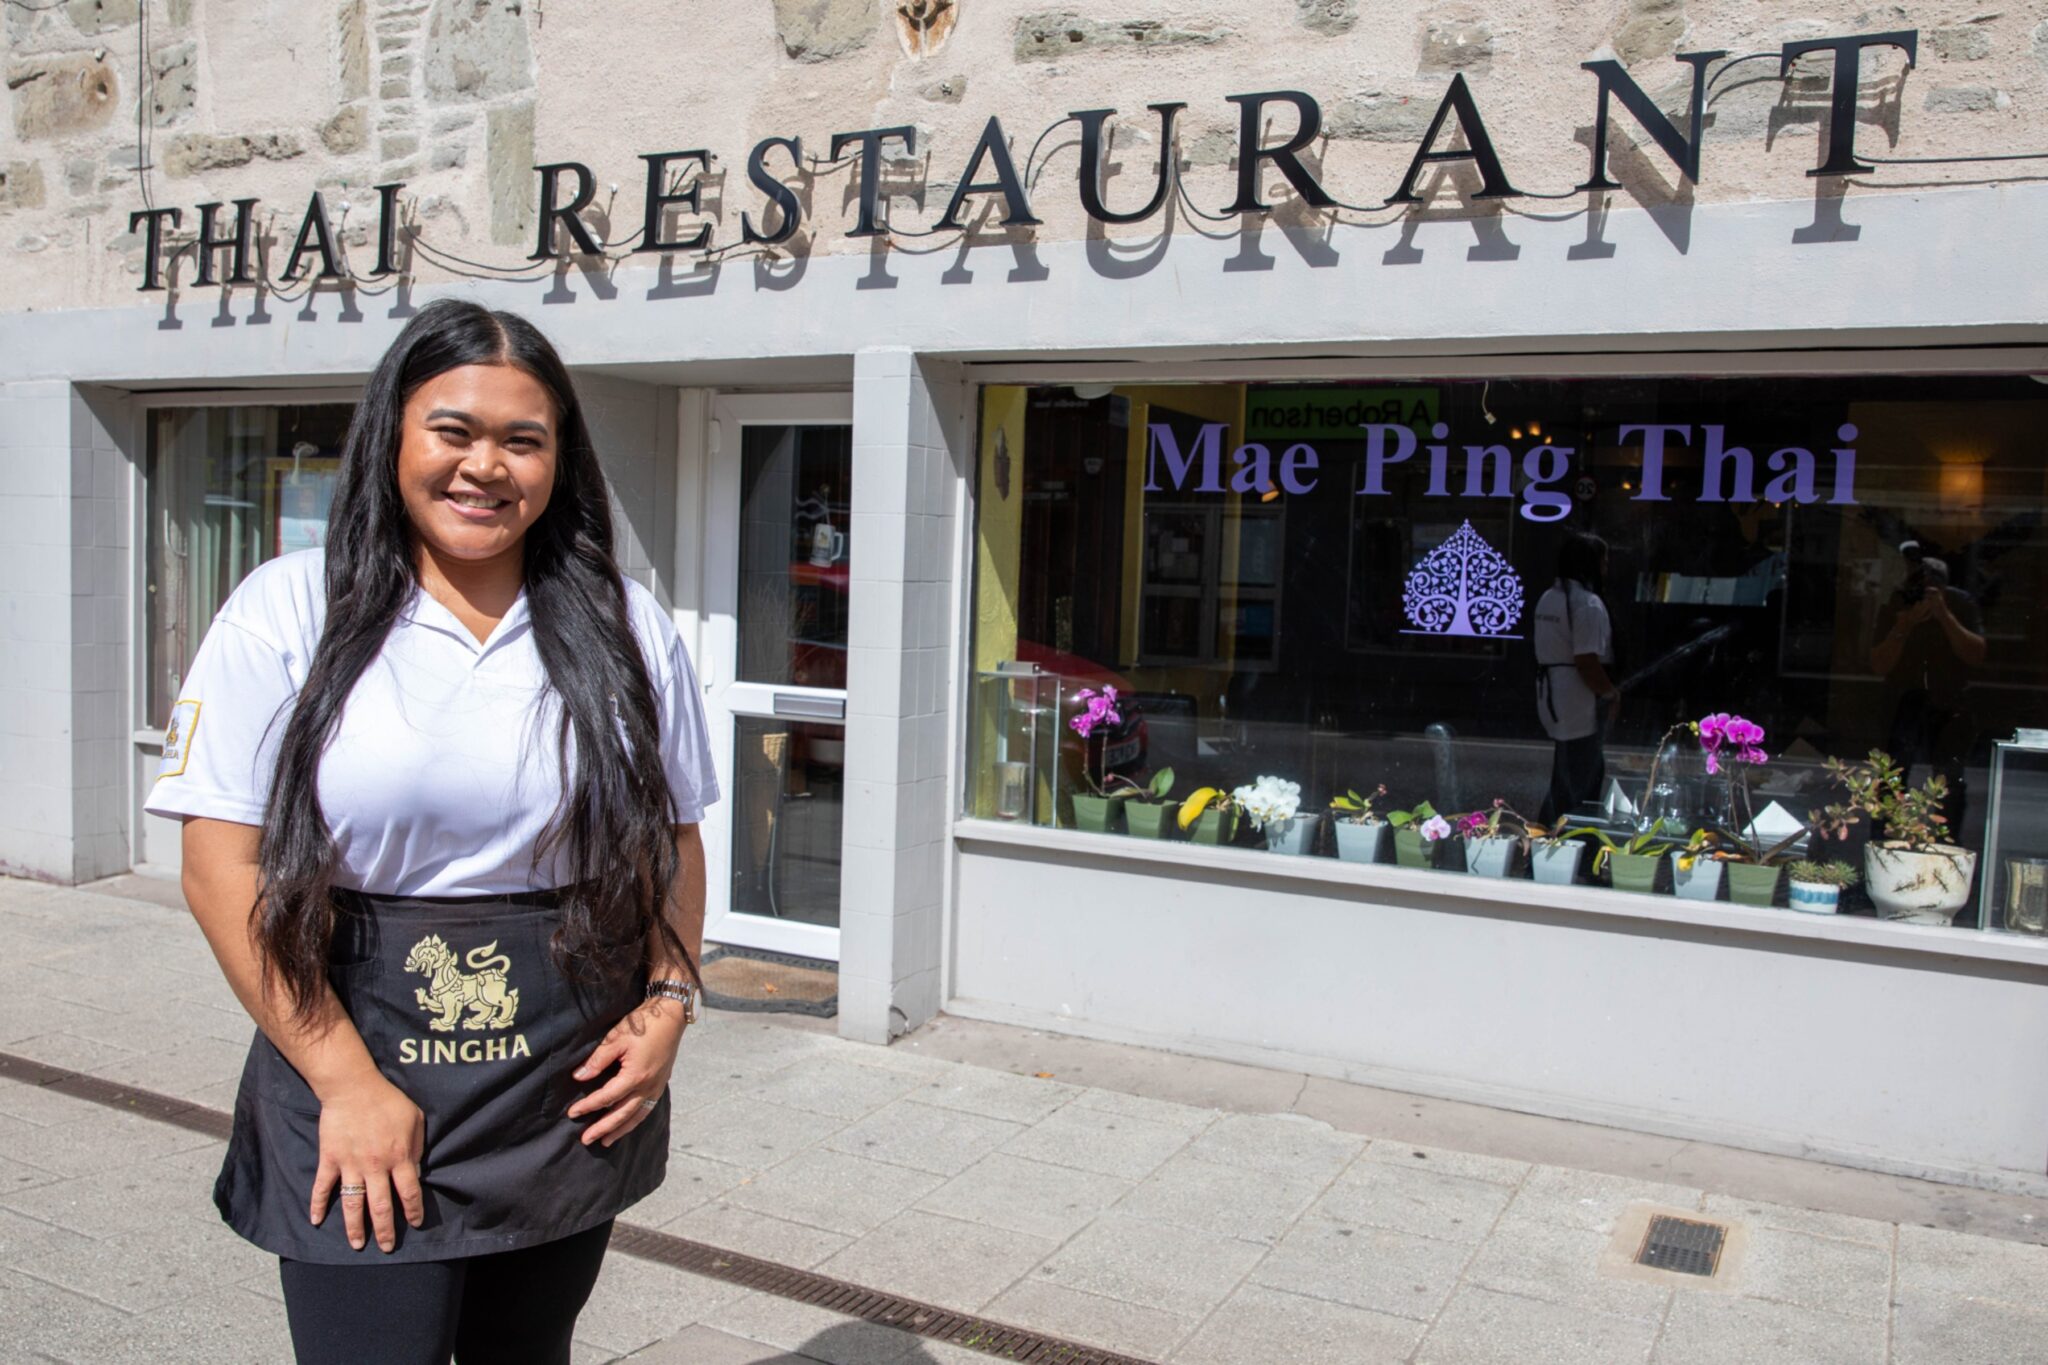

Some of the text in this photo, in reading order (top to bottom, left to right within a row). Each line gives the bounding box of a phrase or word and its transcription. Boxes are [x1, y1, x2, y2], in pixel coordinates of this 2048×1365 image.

[129, 30, 1917, 290] THAI RESTAURANT
[1143, 422, 1860, 523] Mae Ping Thai
[399, 1034, 532, 1064] SINGHA
